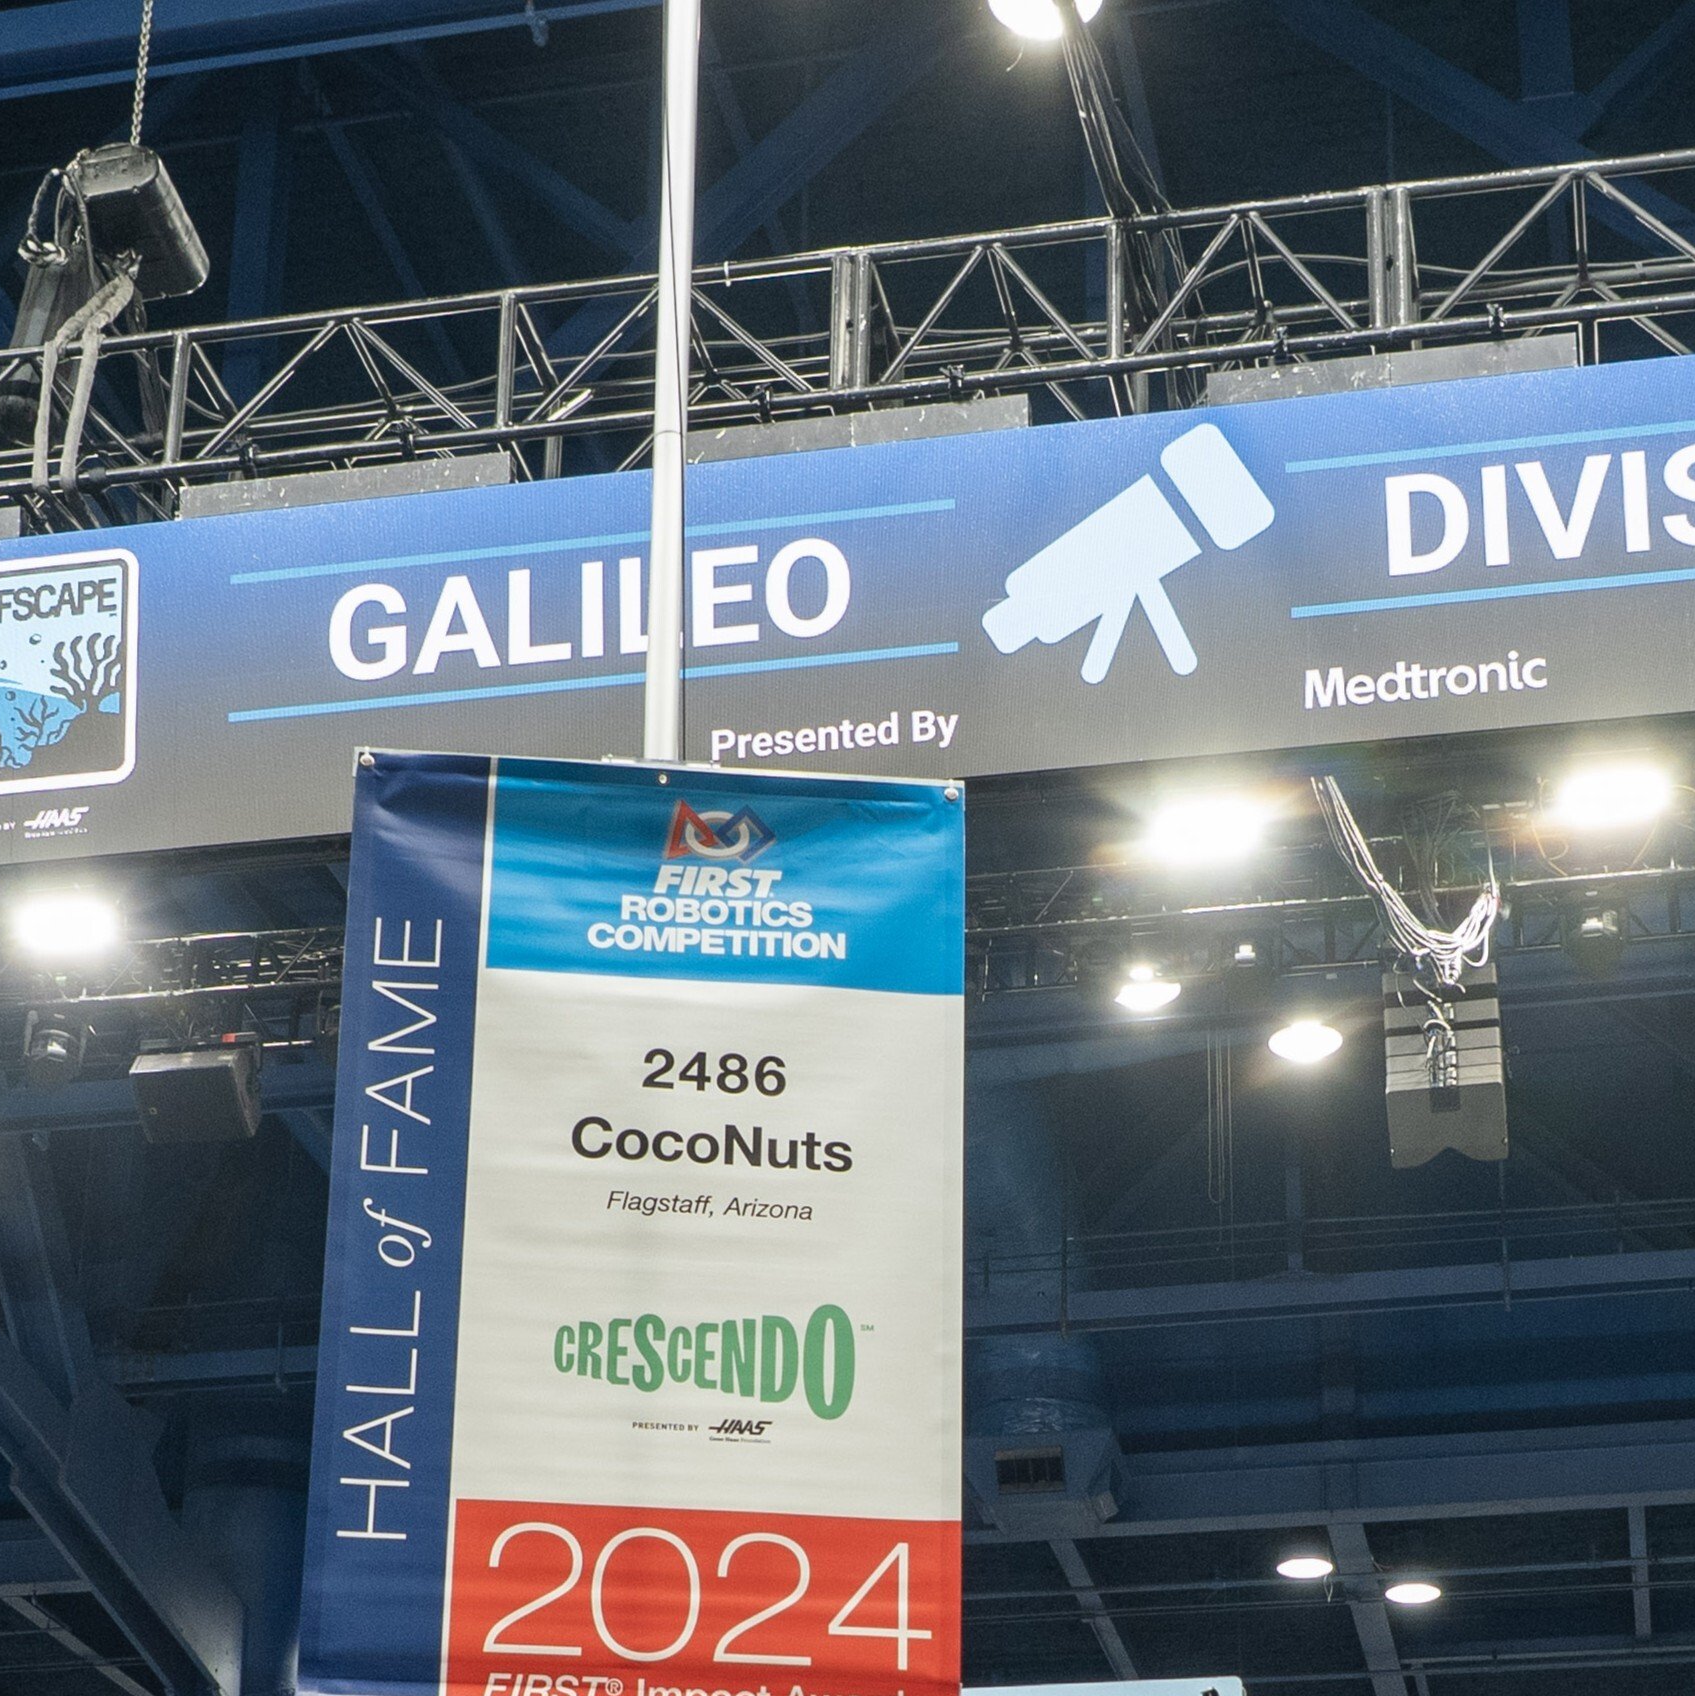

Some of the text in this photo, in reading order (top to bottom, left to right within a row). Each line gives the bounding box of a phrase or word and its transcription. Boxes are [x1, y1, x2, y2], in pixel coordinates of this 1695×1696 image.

[1305, 650, 1548, 709] Medtronic
[711, 710, 959, 761] Presented By
[23, 806, 90, 830] HAAS
[654, 864, 783, 898] FIRST
[620, 894, 813, 928] ROBOTICS
[587, 922, 846, 960] COMPETITION
[642, 1048, 786, 1097] 2486
[571, 1116, 853, 1173] CocoNuts
[606, 1190, 813, 1221] Flagstaff, Arizona
[336, 916, 443, 1541] HALL of FAME
[553, 1303, 856, 1420] CRESCENDO
[632, 1421, 699, 1432] PRESENTED BY
[708, 1418, 773, 1436] HAAS
[482, 1521, 933, 1671] 2024
